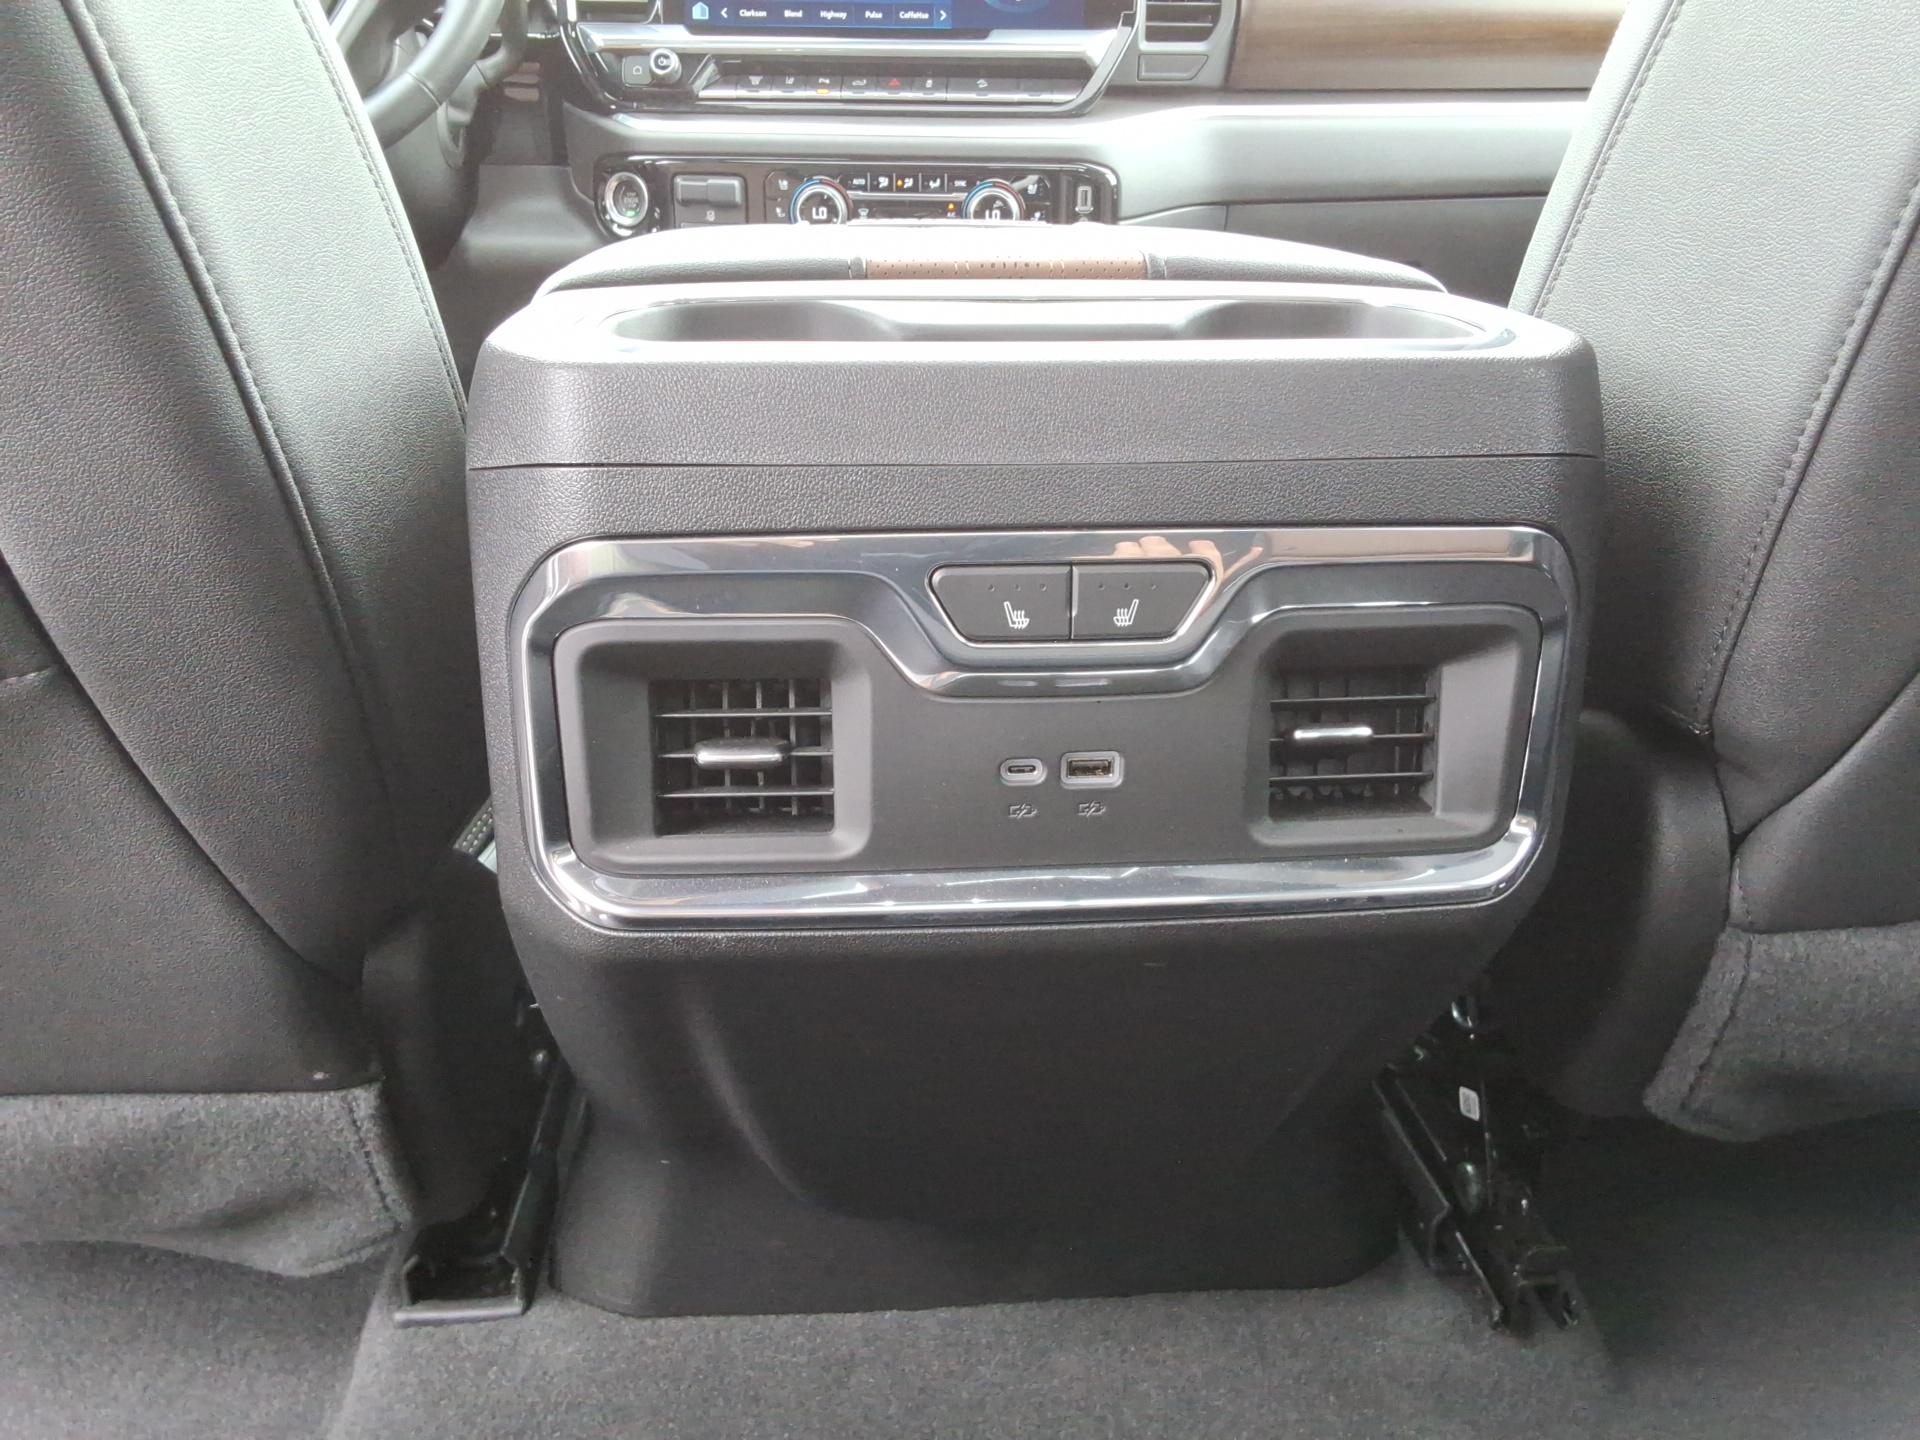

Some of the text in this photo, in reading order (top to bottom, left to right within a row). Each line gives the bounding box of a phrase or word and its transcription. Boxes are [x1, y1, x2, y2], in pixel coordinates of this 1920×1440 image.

[739, 9, 767, 17] Clarkson
[784, 9, 803, 18] Blend
[820, 10, 847, 20] Highway
[865, 10, 883, 19] Pulse
[812, 206, 828, 219] LO
